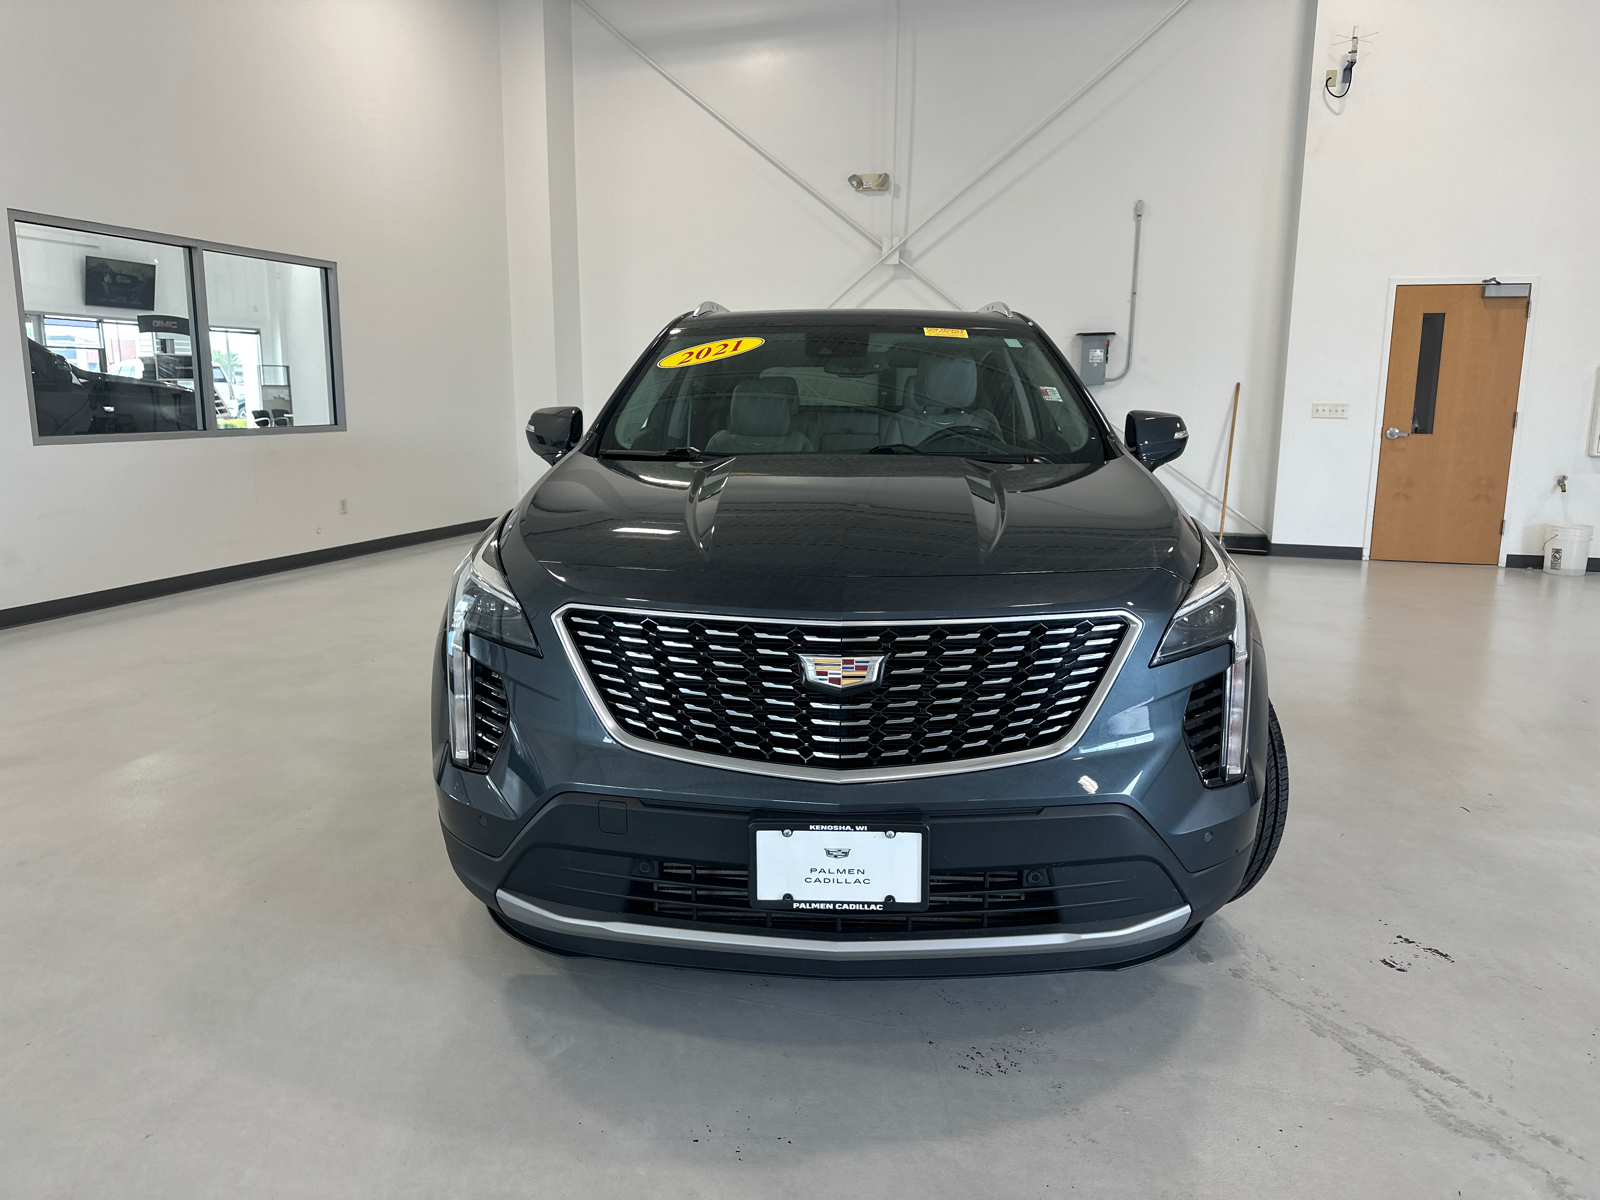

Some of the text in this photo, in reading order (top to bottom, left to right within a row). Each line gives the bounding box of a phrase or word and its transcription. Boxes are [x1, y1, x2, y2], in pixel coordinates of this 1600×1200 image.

[152, 320, 178, 329] GMC
[677, 340, 743, 366] 2021
[804, 877, 871, 885] CADILLAC
[793, 902, 884, 911] PALMEN CADILLAC
